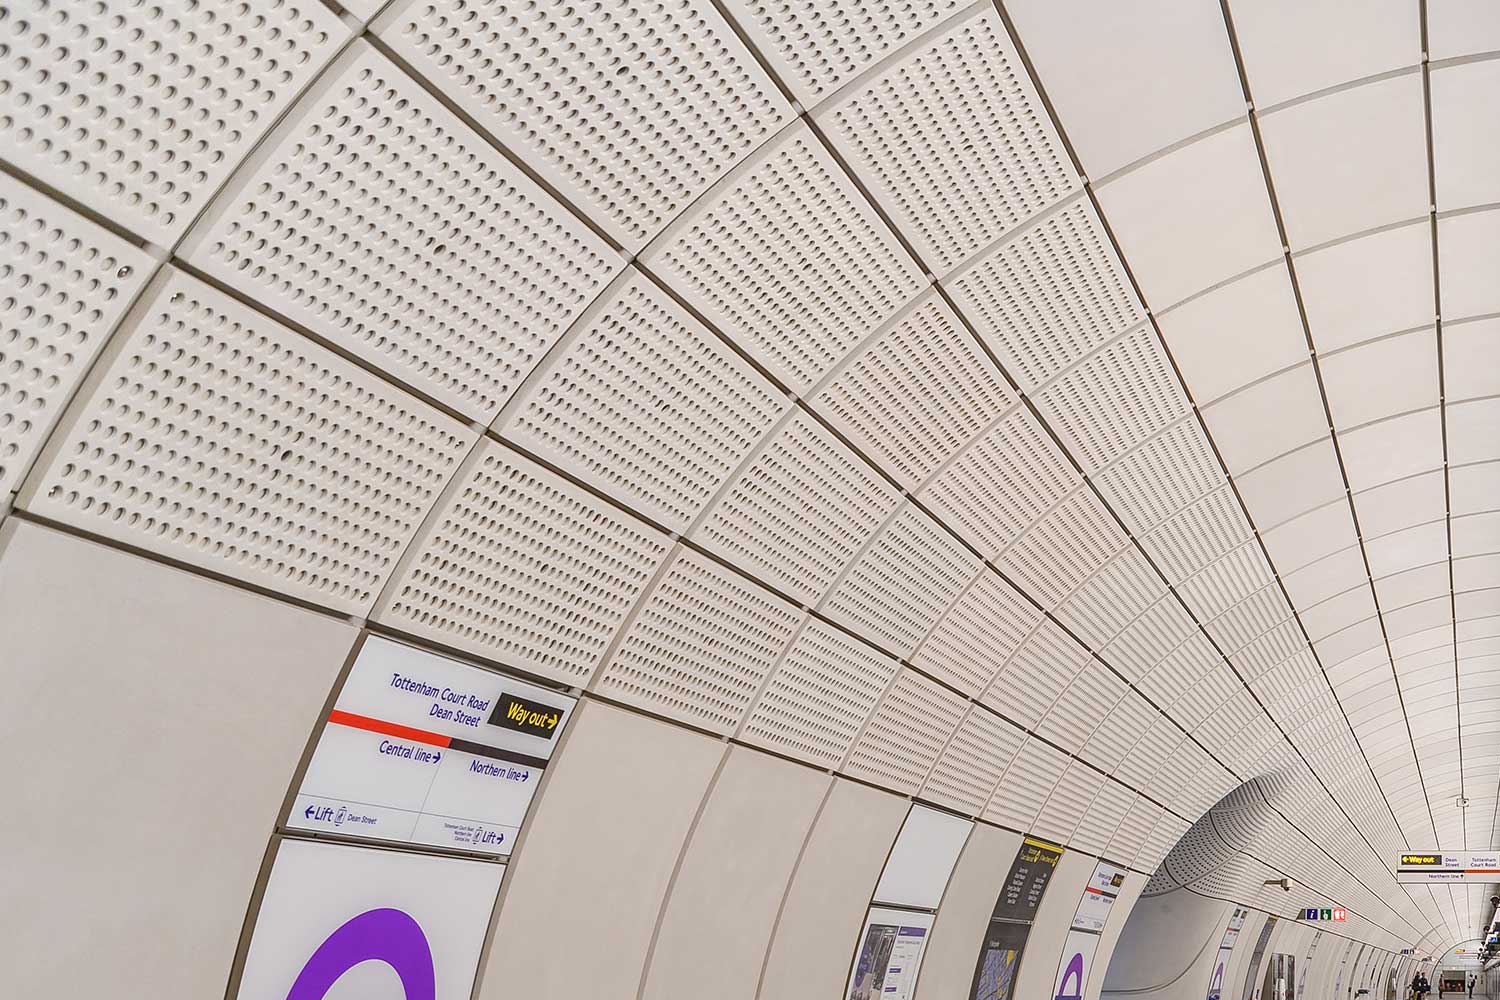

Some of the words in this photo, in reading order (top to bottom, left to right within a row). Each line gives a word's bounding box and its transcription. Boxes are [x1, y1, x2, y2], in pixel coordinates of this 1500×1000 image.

[390, 673, 440, 698] Tottenham
[441, 688, 467, 705] Court
[467, 695, 490, 711] Road
[429, 704, 453, 720] Dean
[453, 710, 482, 727] Street
[507, 702, 530, 726] Way
[529, 712, 548, 727] out
[379, 740, 415, 759] Central
[414, 748, 432, 763] line
[469, 760, 506, 778] Northern
[506, 768, 522, 782] line
[314, 806, 334, 822] Lift
[347, 814, 361, 822] Dean
[361, 815, 377, 824] Street
[482, 831, 497, 844] Lift
[1409, 856, 1423, 865] Way
